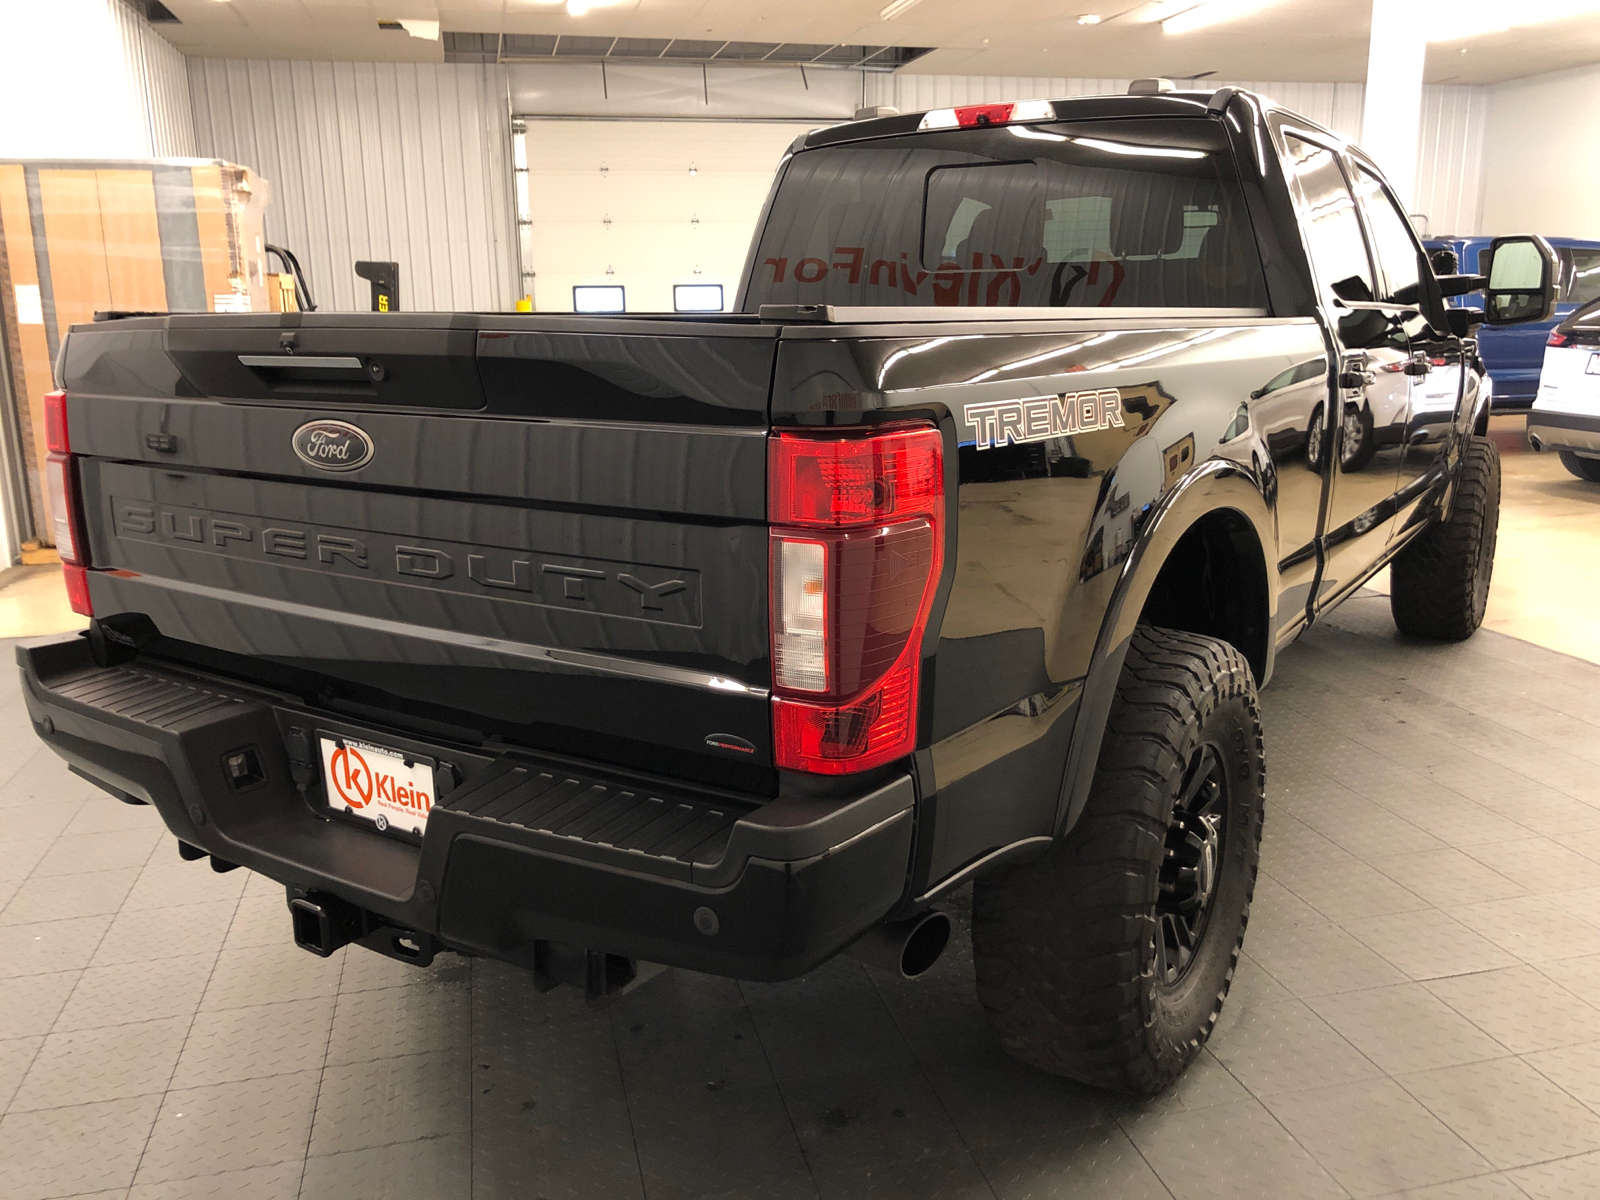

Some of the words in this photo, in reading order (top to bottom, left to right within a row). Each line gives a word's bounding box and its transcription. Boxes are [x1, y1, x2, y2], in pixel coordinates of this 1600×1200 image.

[964, 388, 1125, 451] TREMOR
[307, 430, 350, 460] Ford
[117, 504, 370, 570] SUPER
[396, 543, 687, 611] DUTY
[342, 738, 403, 759] www.kleinauto.com
[375, 771, 430, 812] Klein
